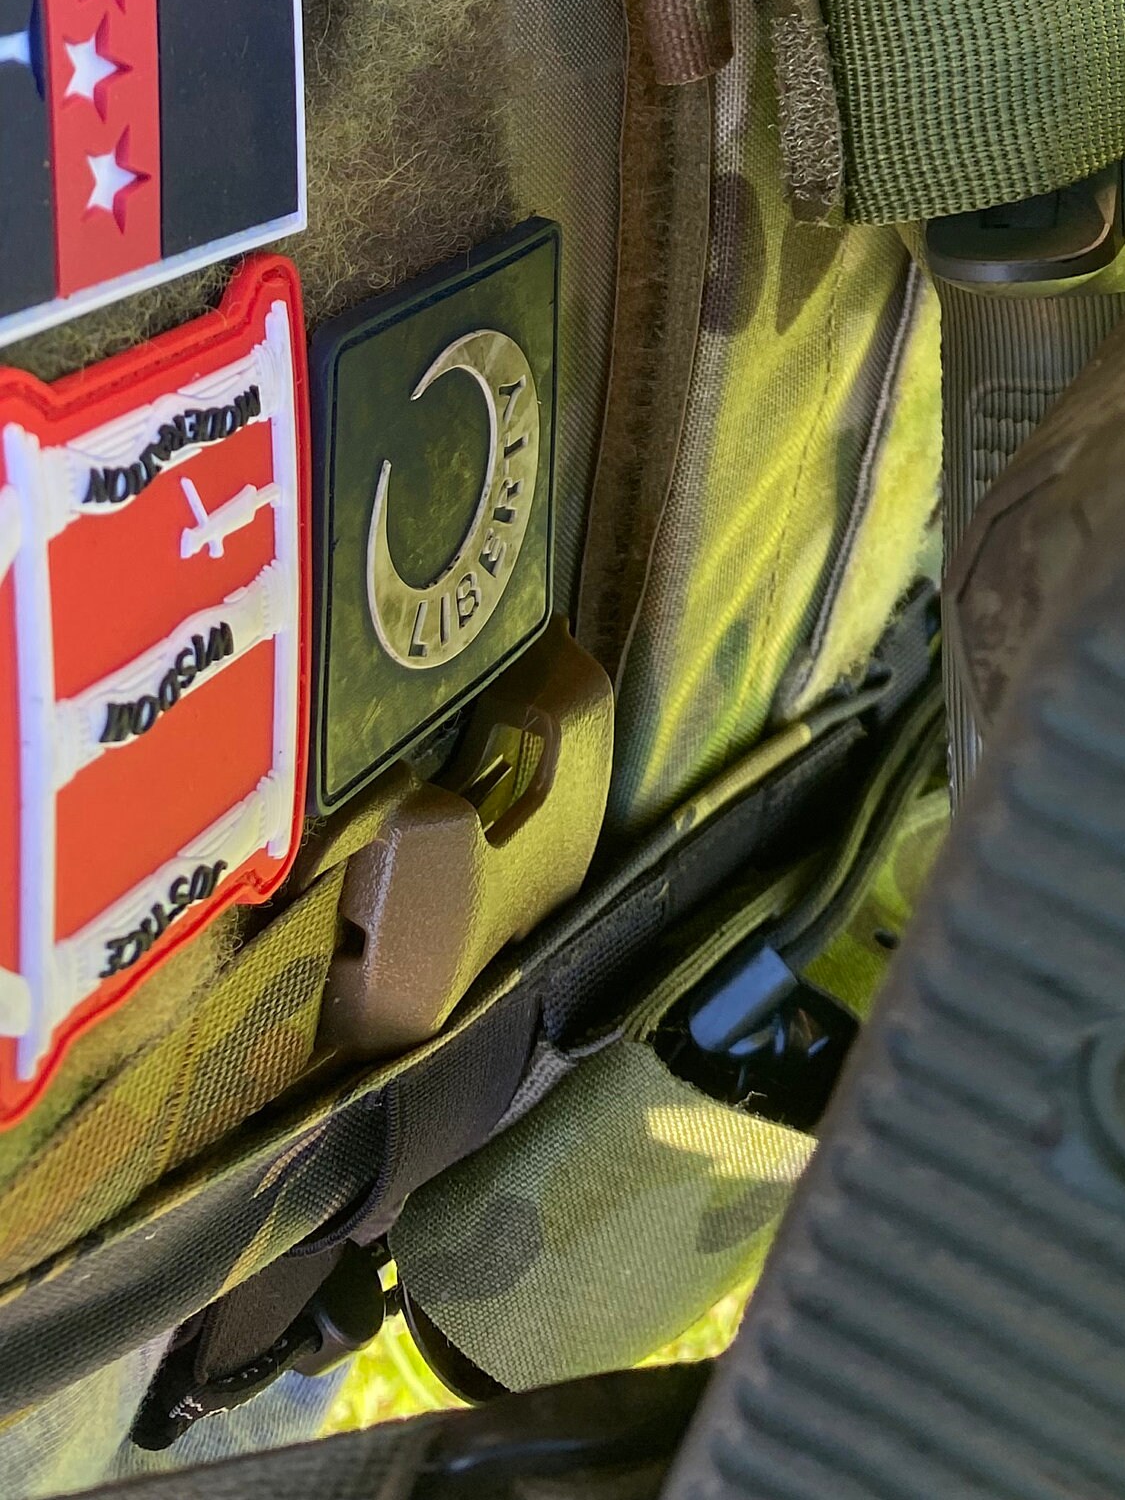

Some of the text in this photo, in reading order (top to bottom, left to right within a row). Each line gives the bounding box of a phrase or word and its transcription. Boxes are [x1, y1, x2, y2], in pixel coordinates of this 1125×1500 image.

[82, 384, 262, 504] MODERATION
[408, 375, 529, 657] LIBERTY
[99, 621, 234, 743] WISDOM
[99, 859, 228, 978] JUSTICE
